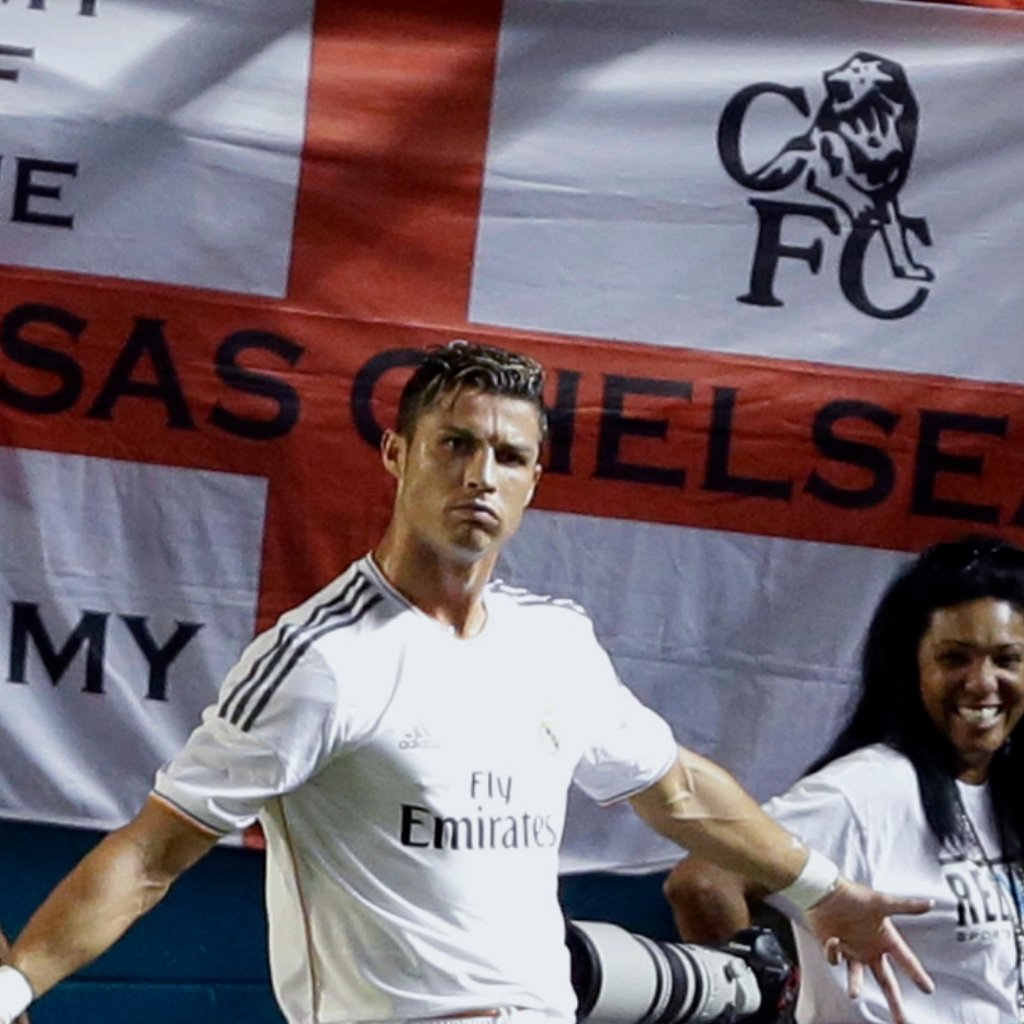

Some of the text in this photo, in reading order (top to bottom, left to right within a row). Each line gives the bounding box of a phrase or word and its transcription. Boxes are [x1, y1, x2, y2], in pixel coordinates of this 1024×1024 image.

[0, 155, 79, 230] E
[0, 302, 307, 442] SAS
[7, 600, 205, 702] MY
[470, 771, 512, 804] Fly
[400, 803, 557, 850] Emirates
